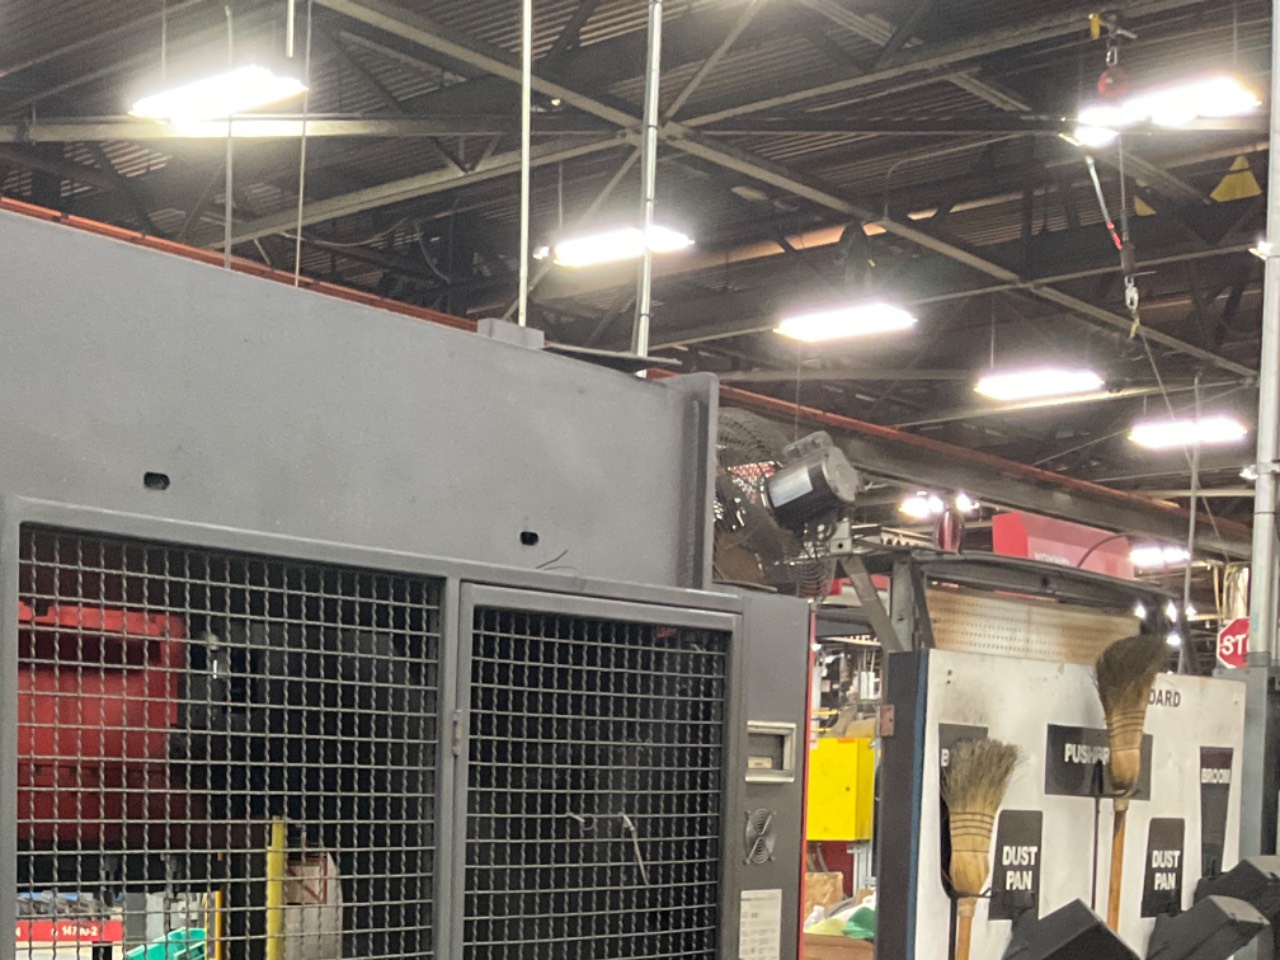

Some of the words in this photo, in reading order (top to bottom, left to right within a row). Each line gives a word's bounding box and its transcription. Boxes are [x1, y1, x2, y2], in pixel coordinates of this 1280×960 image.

[1221, 634, 1249, 655] ST
[1149, 689, 1181, 707] OARD
[1201, 767, 1232, 784] BROOM
[1002, 846, 1038, 866] DUST
[1151, 850, 1181, 868] DUST
[1005, 870, 1033, 890] PAN
[1154, 872, 1177, 890] PAN
